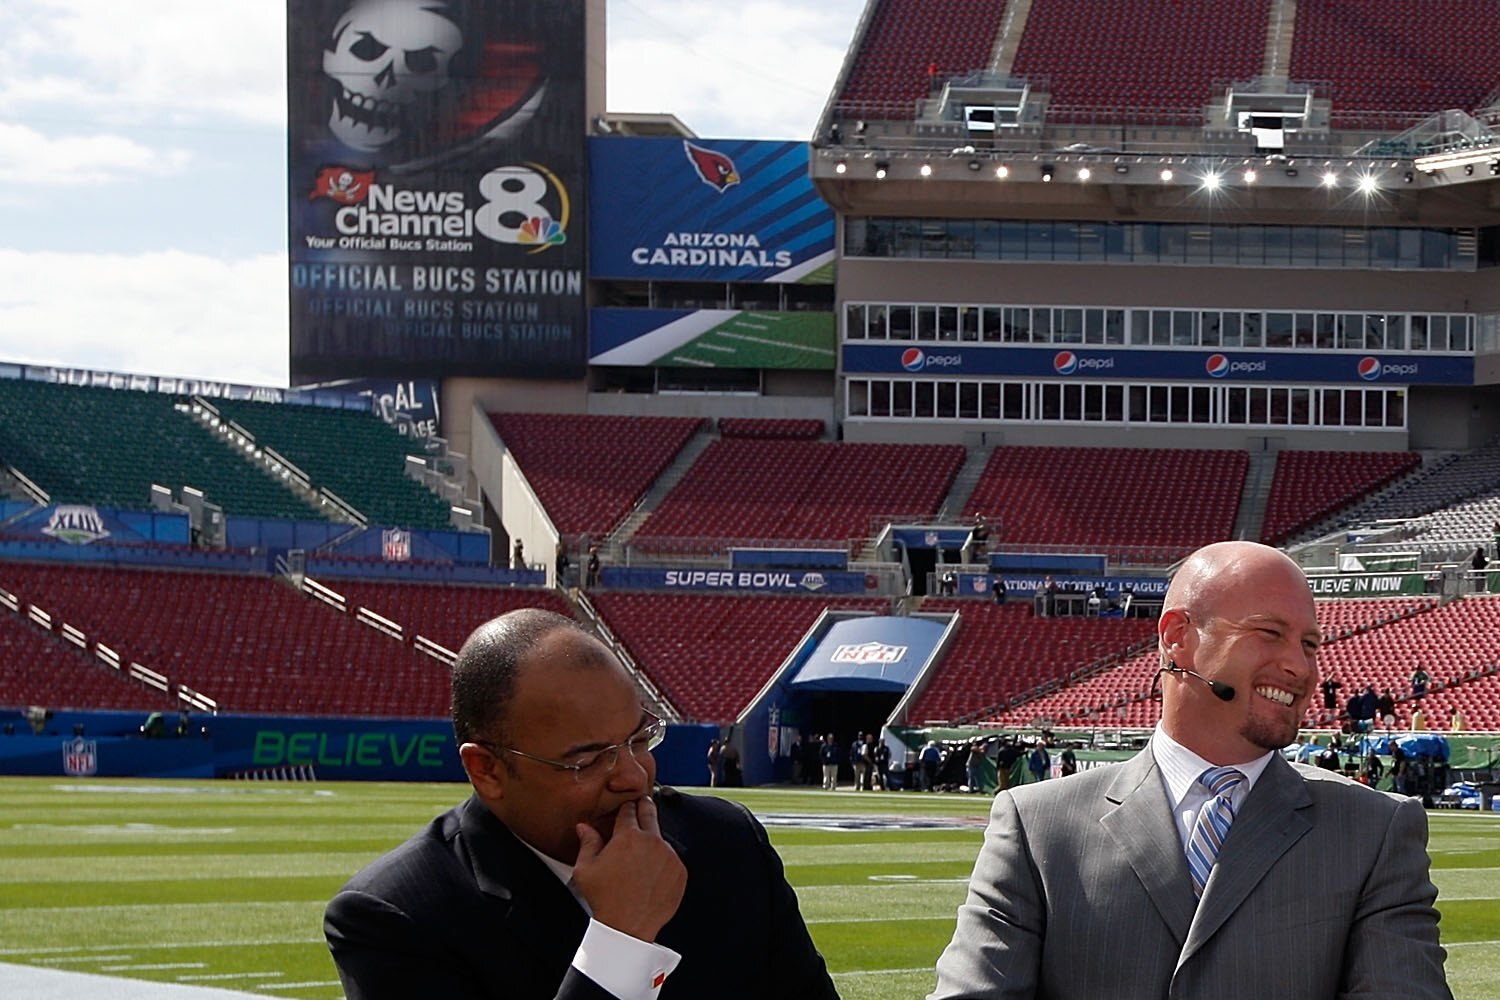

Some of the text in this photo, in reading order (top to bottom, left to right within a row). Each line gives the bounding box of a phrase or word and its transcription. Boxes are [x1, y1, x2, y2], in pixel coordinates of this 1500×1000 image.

[335, 166, 553, 244] Channel 8
[368, 184, 464, 213] News
[306, 235, 473, 252] Your Official Bucs Station
[664, 232, 760, 247] ARIZONA
[631, 247, 793, 268] CARDINALS
[293, 263, 582, 296] OFFICIAL BUCS STATION
[309, 299, 539, 321] OFFICIAL BUCS STATION
[462, 324, 502, 339] BUCS
[925, 352, 962, 367] pepsi
[1078, 356, 1114, 370] pepsi
[1230, 359, 1266, 373] pepsi
[1382, 362, 1418, 376] pepsi
[665, 571, 733, 586] SUPER
[738, 573, 797, 588] BOWL
[1354, 577, 1368, 591] IN
[1371, 576, 1402, 591] NOW
[253, 731, 447, 766] BELIEVE
[67, 754, 94, 771] NFL
